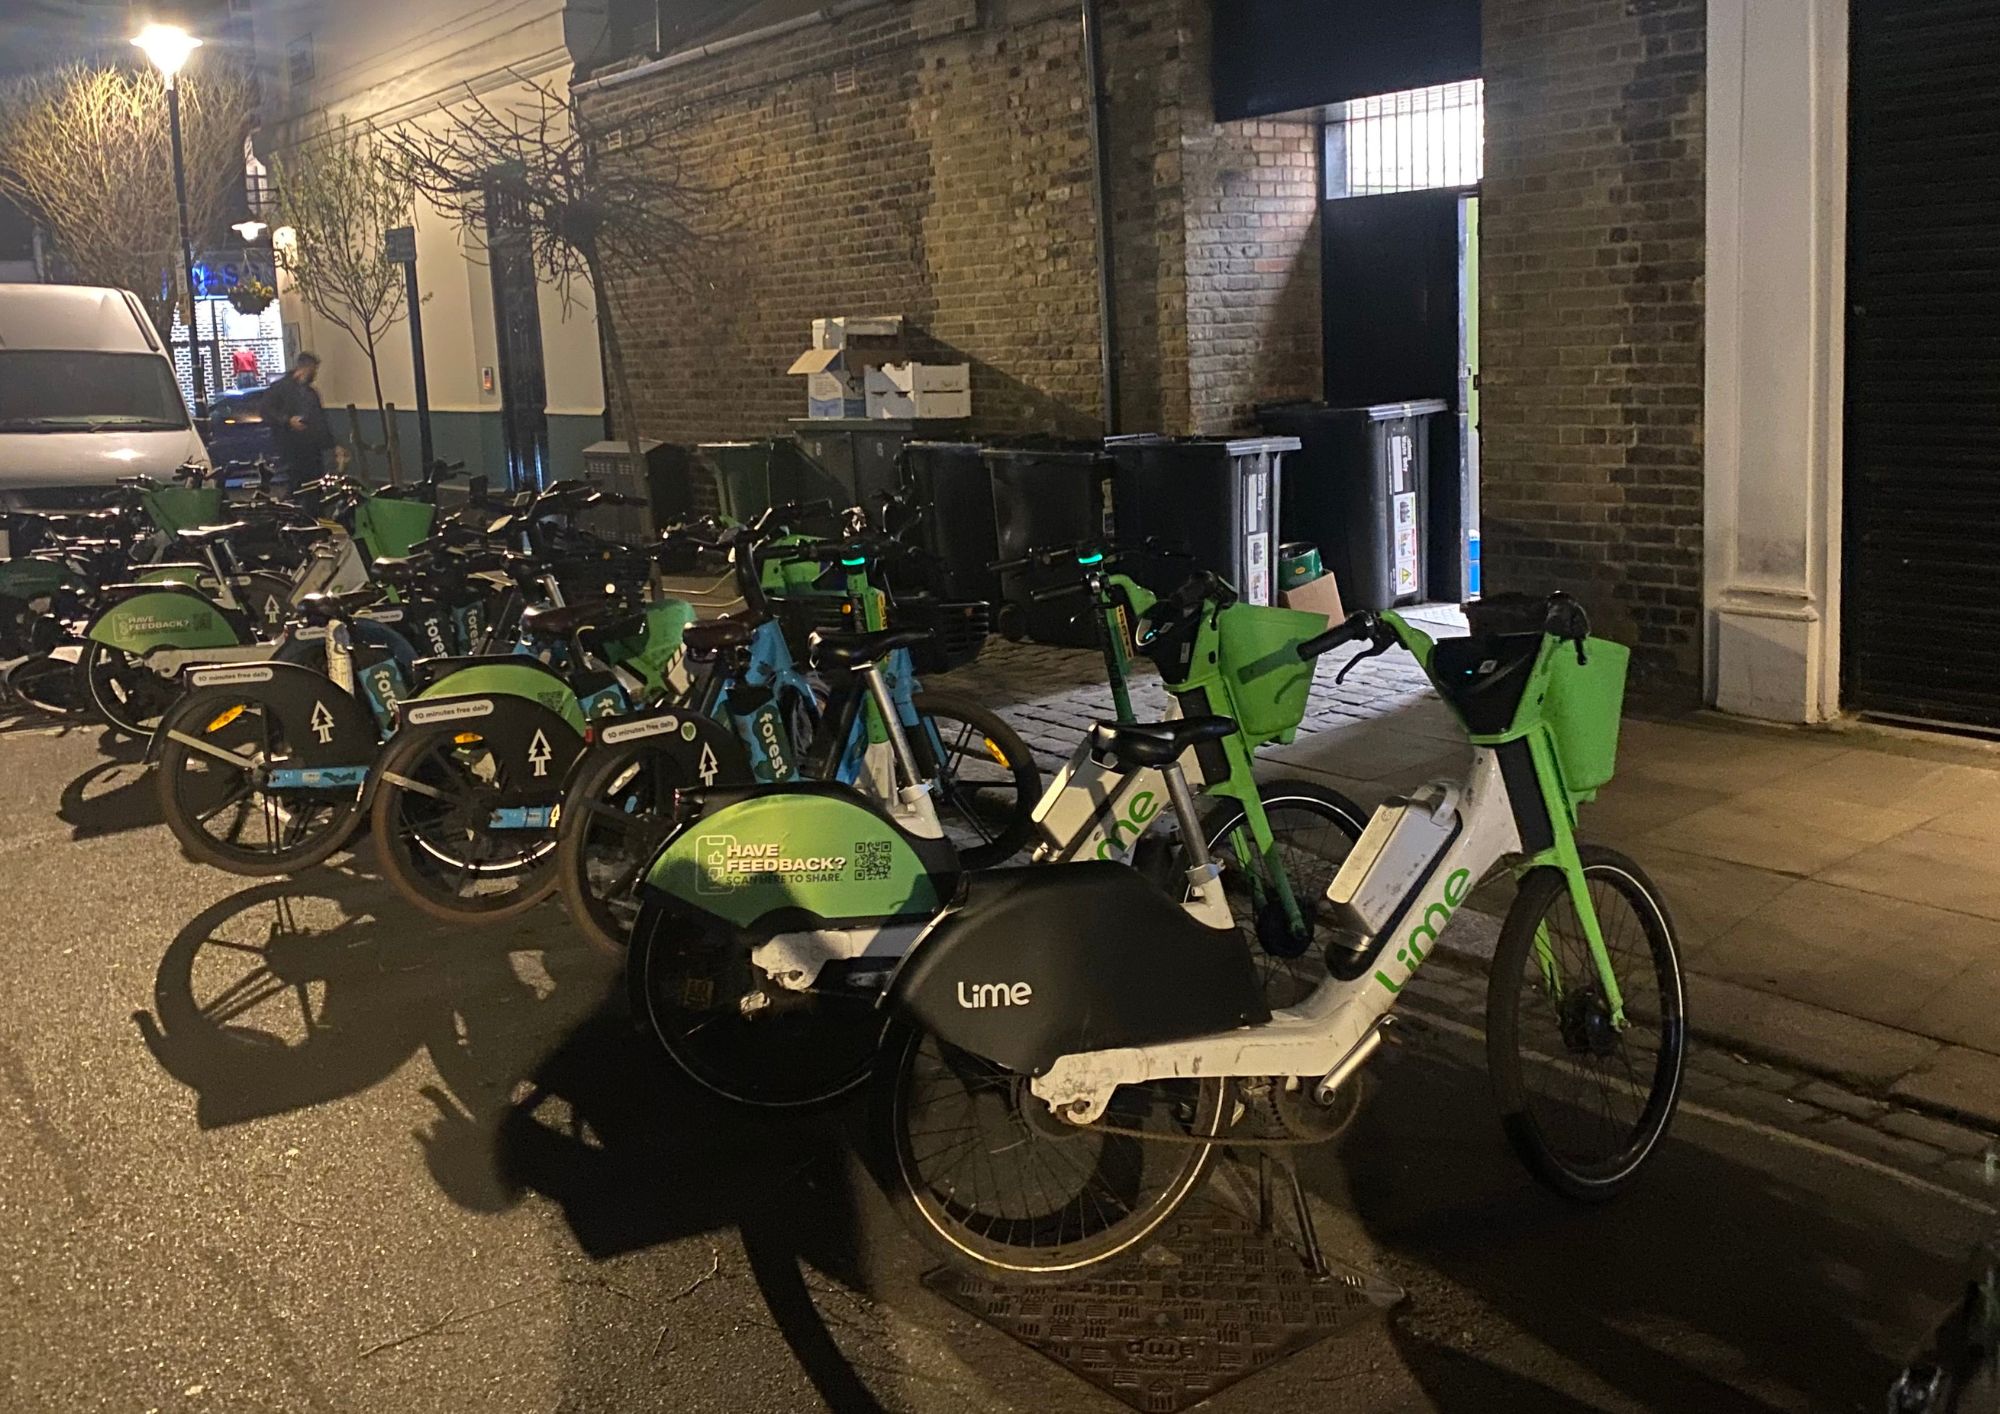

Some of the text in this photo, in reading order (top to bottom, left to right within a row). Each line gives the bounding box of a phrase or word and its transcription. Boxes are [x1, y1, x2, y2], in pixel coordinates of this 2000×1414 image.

[374, 670, 398, 717] fore
[425, 709, 455, 718] minutes
[472, 703, 489, 712] daily
[607, 731, 617, 739] 10
[618, 726, 645, 736] minutes
[660, 720, 674, 728] daily
[759, 712, 788, 778] forest
[726, 843, 779, 858] HAVE
[726, 856, 846, 873] FEEDBACK?
[726, 875, 759, 885] SCAN
[789, 874, 804, 883] TO
[805, 872, 844, 883] SHARE.
[1374, 868, 1472, 993] Lime
[957, 981, 1033, 1008] Lime
